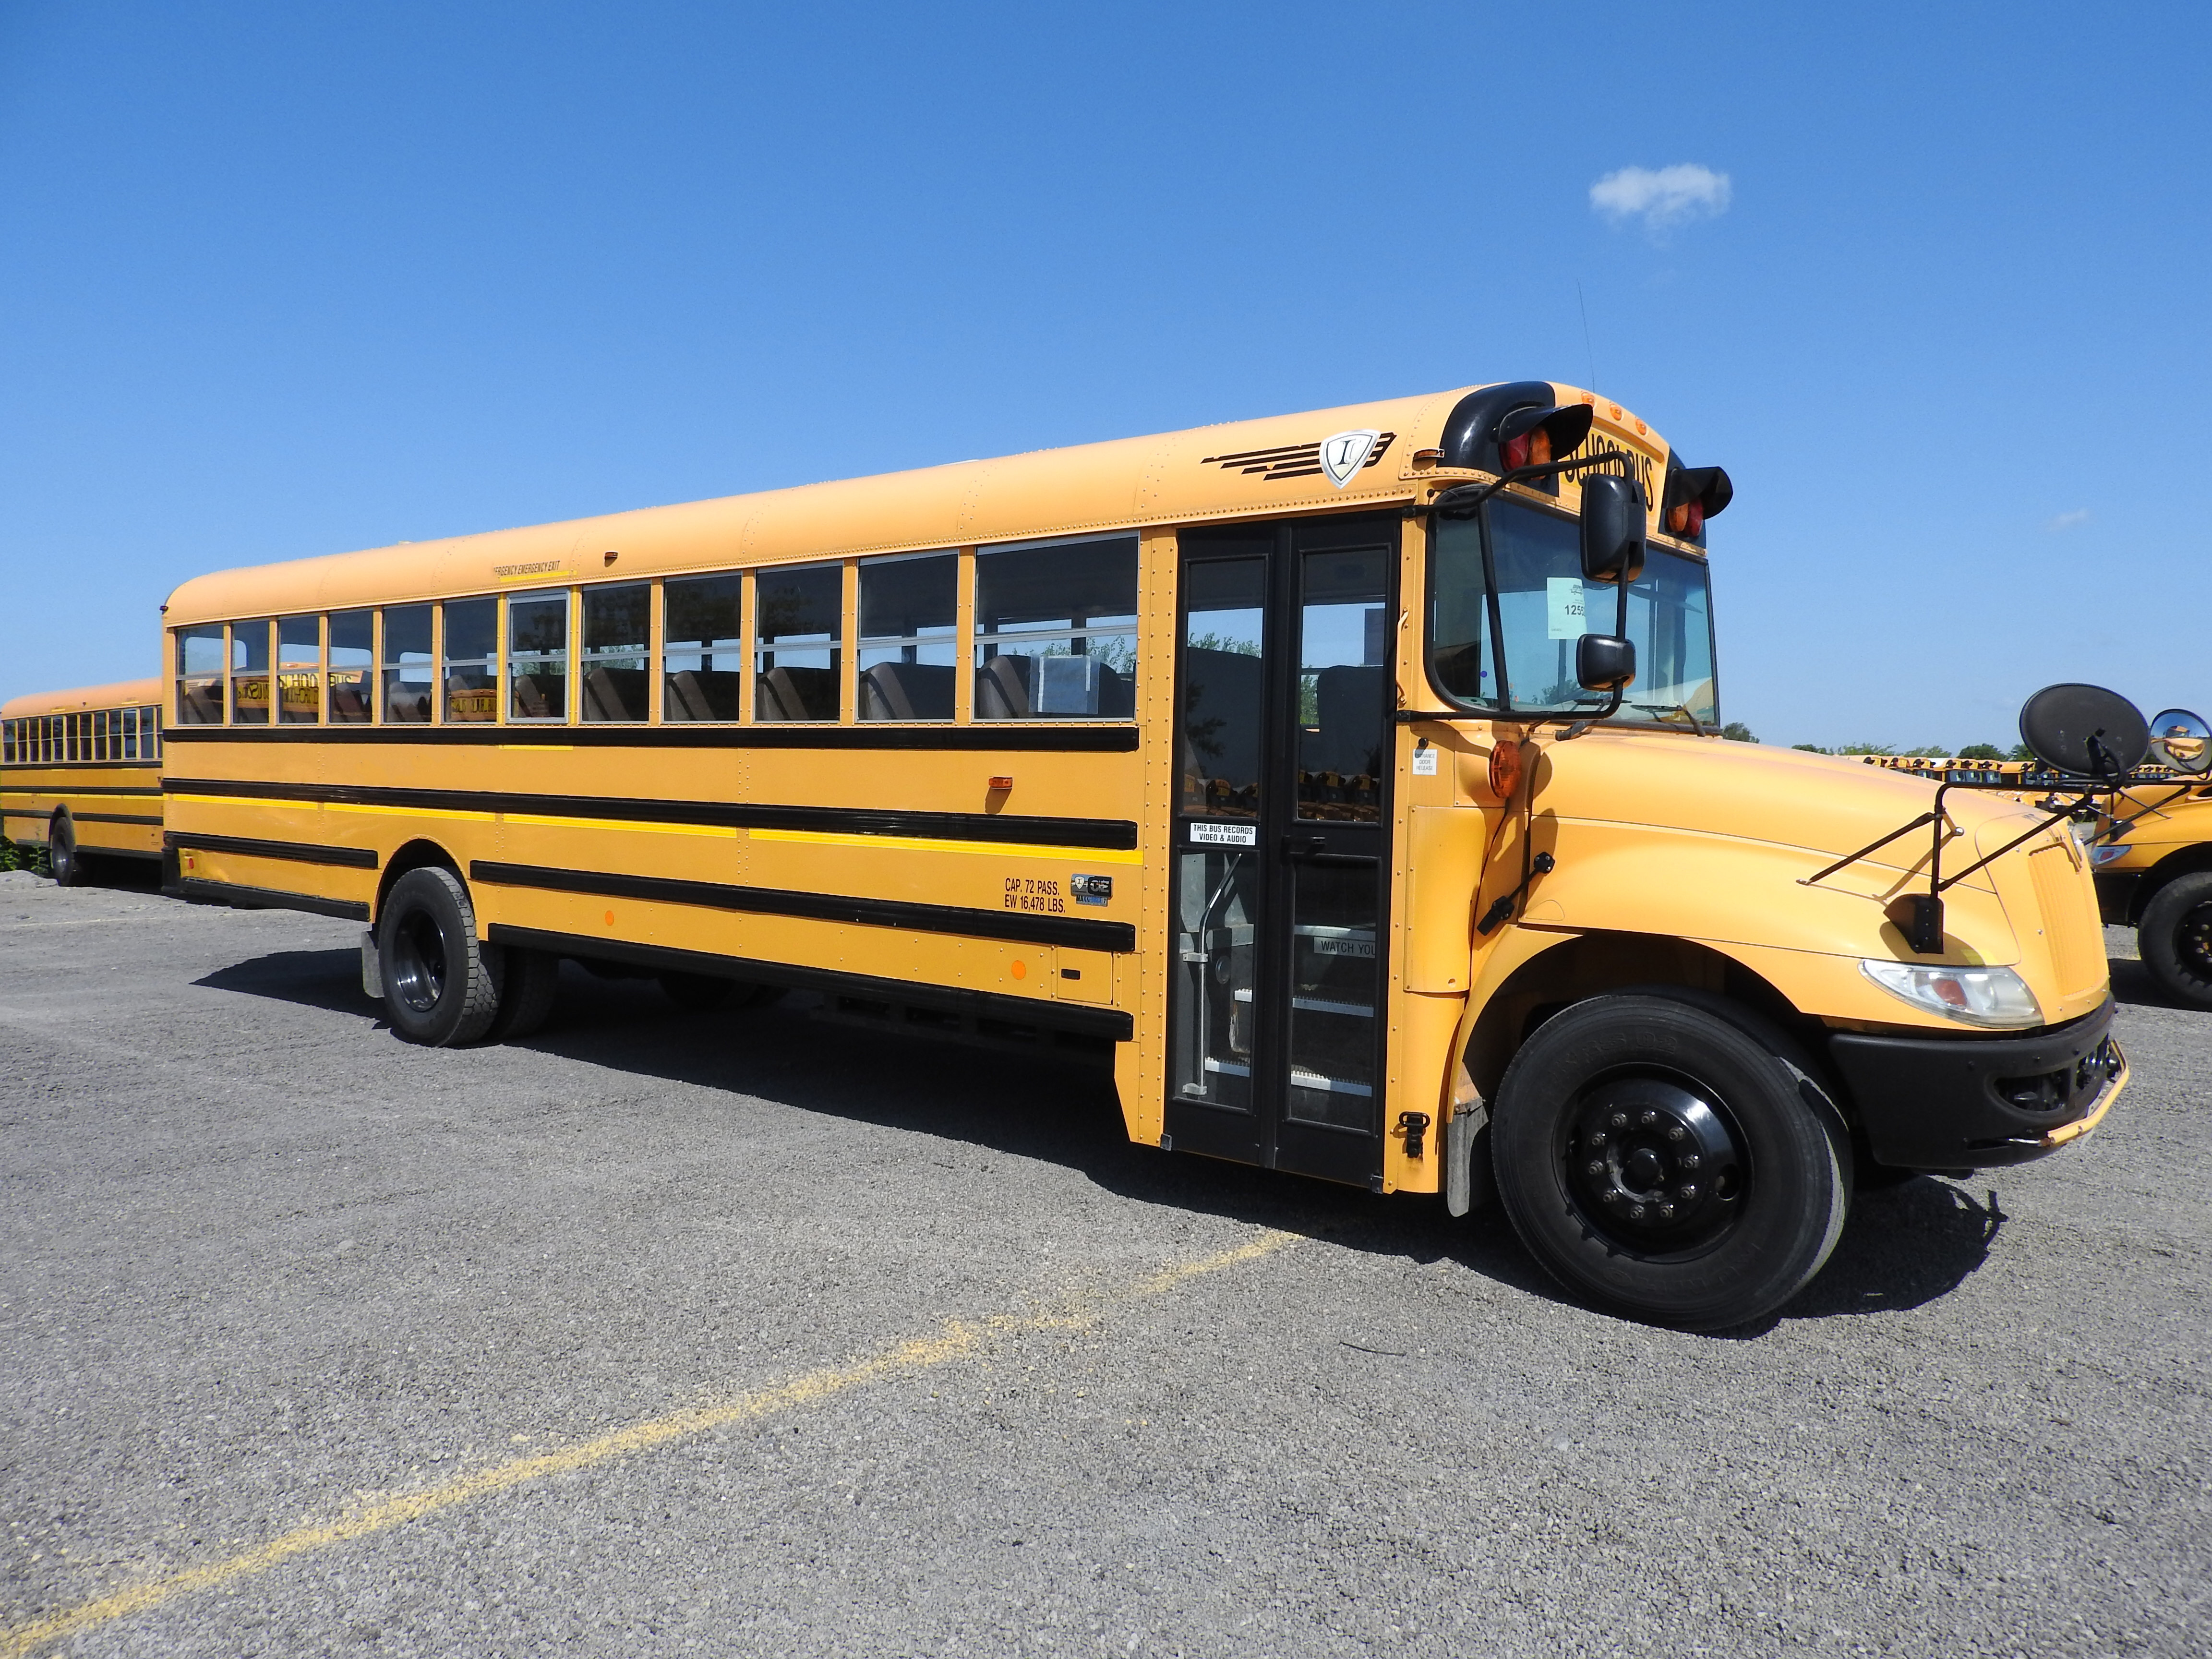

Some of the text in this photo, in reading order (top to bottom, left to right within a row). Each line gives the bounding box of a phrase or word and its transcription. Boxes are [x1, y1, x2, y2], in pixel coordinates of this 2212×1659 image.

[493, 560, 560, 576] ERGENCY EMERGENCY EXIT
[1224, 826, 1253, 834] RECORDS
[1199, 833, 1218, 841] VIDEO
[1227, 835, 1246, 843] AUDIO
[1005, 878, 1059, 896] CAP. 72 PASS.
[1005, 894, 1017, 908] EW
[1020, 895, 1045, 912] 16,478
[1048, 898, 1066, 913] LBS.
[1321, 940, 1354, 953] WATCH
